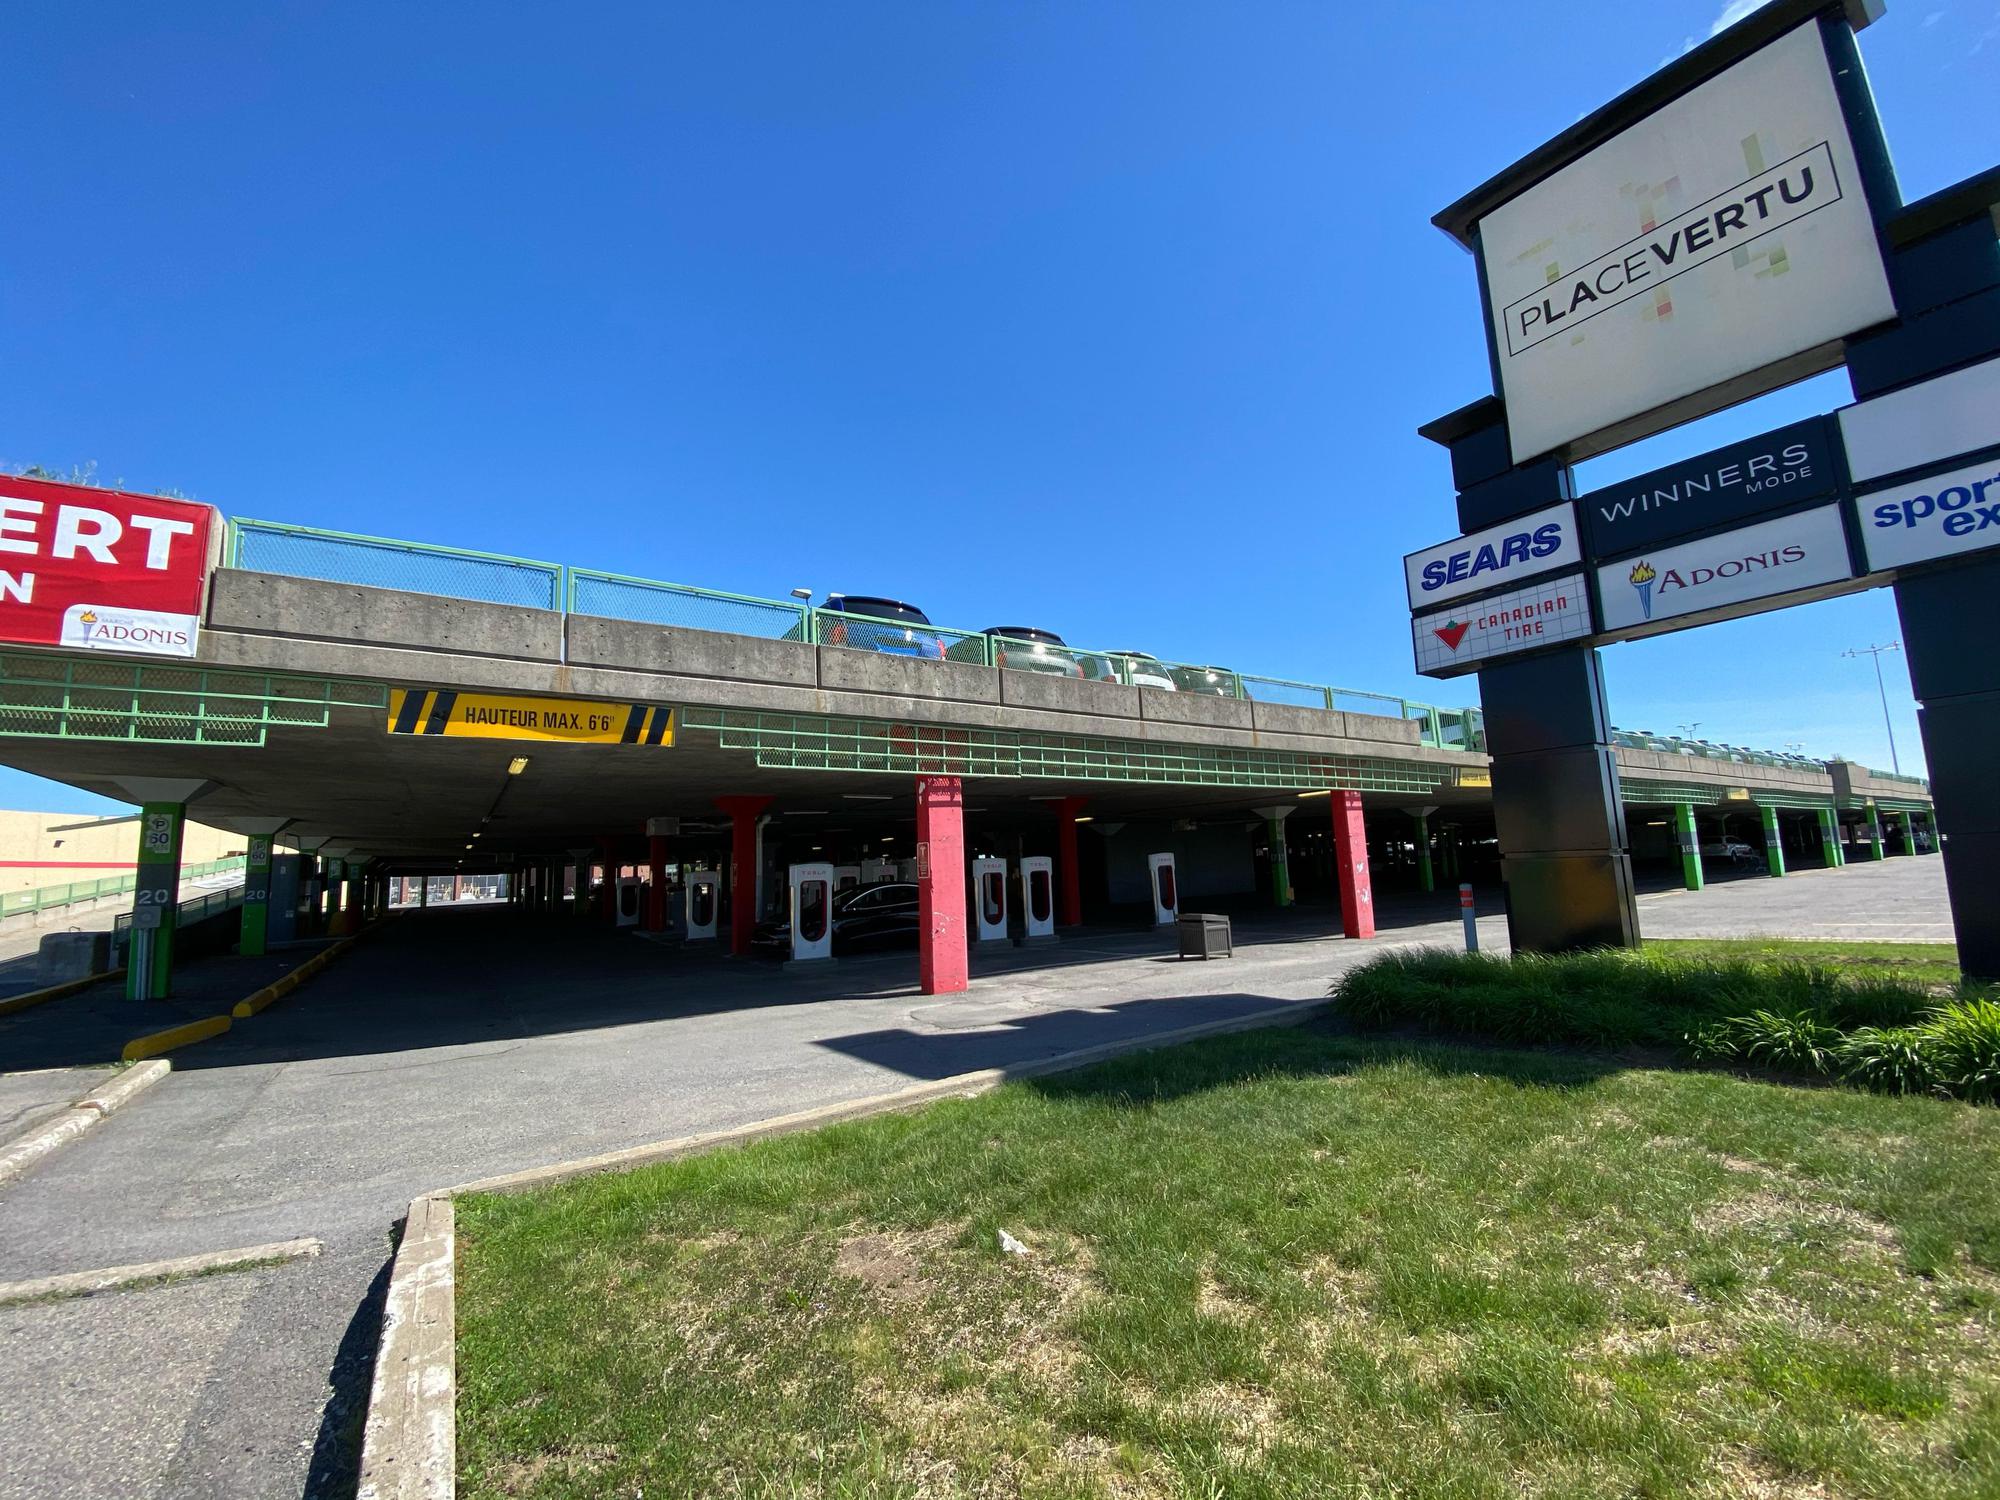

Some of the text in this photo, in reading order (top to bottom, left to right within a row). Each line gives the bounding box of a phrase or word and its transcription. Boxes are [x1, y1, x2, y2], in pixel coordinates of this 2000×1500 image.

[1600, 444, 1809, 522] WINNERS
[1746, 466, 1813, 495] MODE
[1874, 472, 2000, 528] spor
[1421, 523, 1562, 591] SEARS
[1657, 545, 1806, 594] ADONIS
[1478, 597, 1568, 630] CANADIAN
[95, 625, 188, 645] ADONIS
[1505, 621, 1544, 641] TIRE
[465, 706, 538, 728] HAUTEUR
[543, 712, 583, 730] MAX.
[151, 832, 169, 844] 60
[1681, 845, 1692, 853] 16
[252, 851, 266, 860] 60
[138, 888, 169, 904] 20
[246, 889, 266, 900] 20
